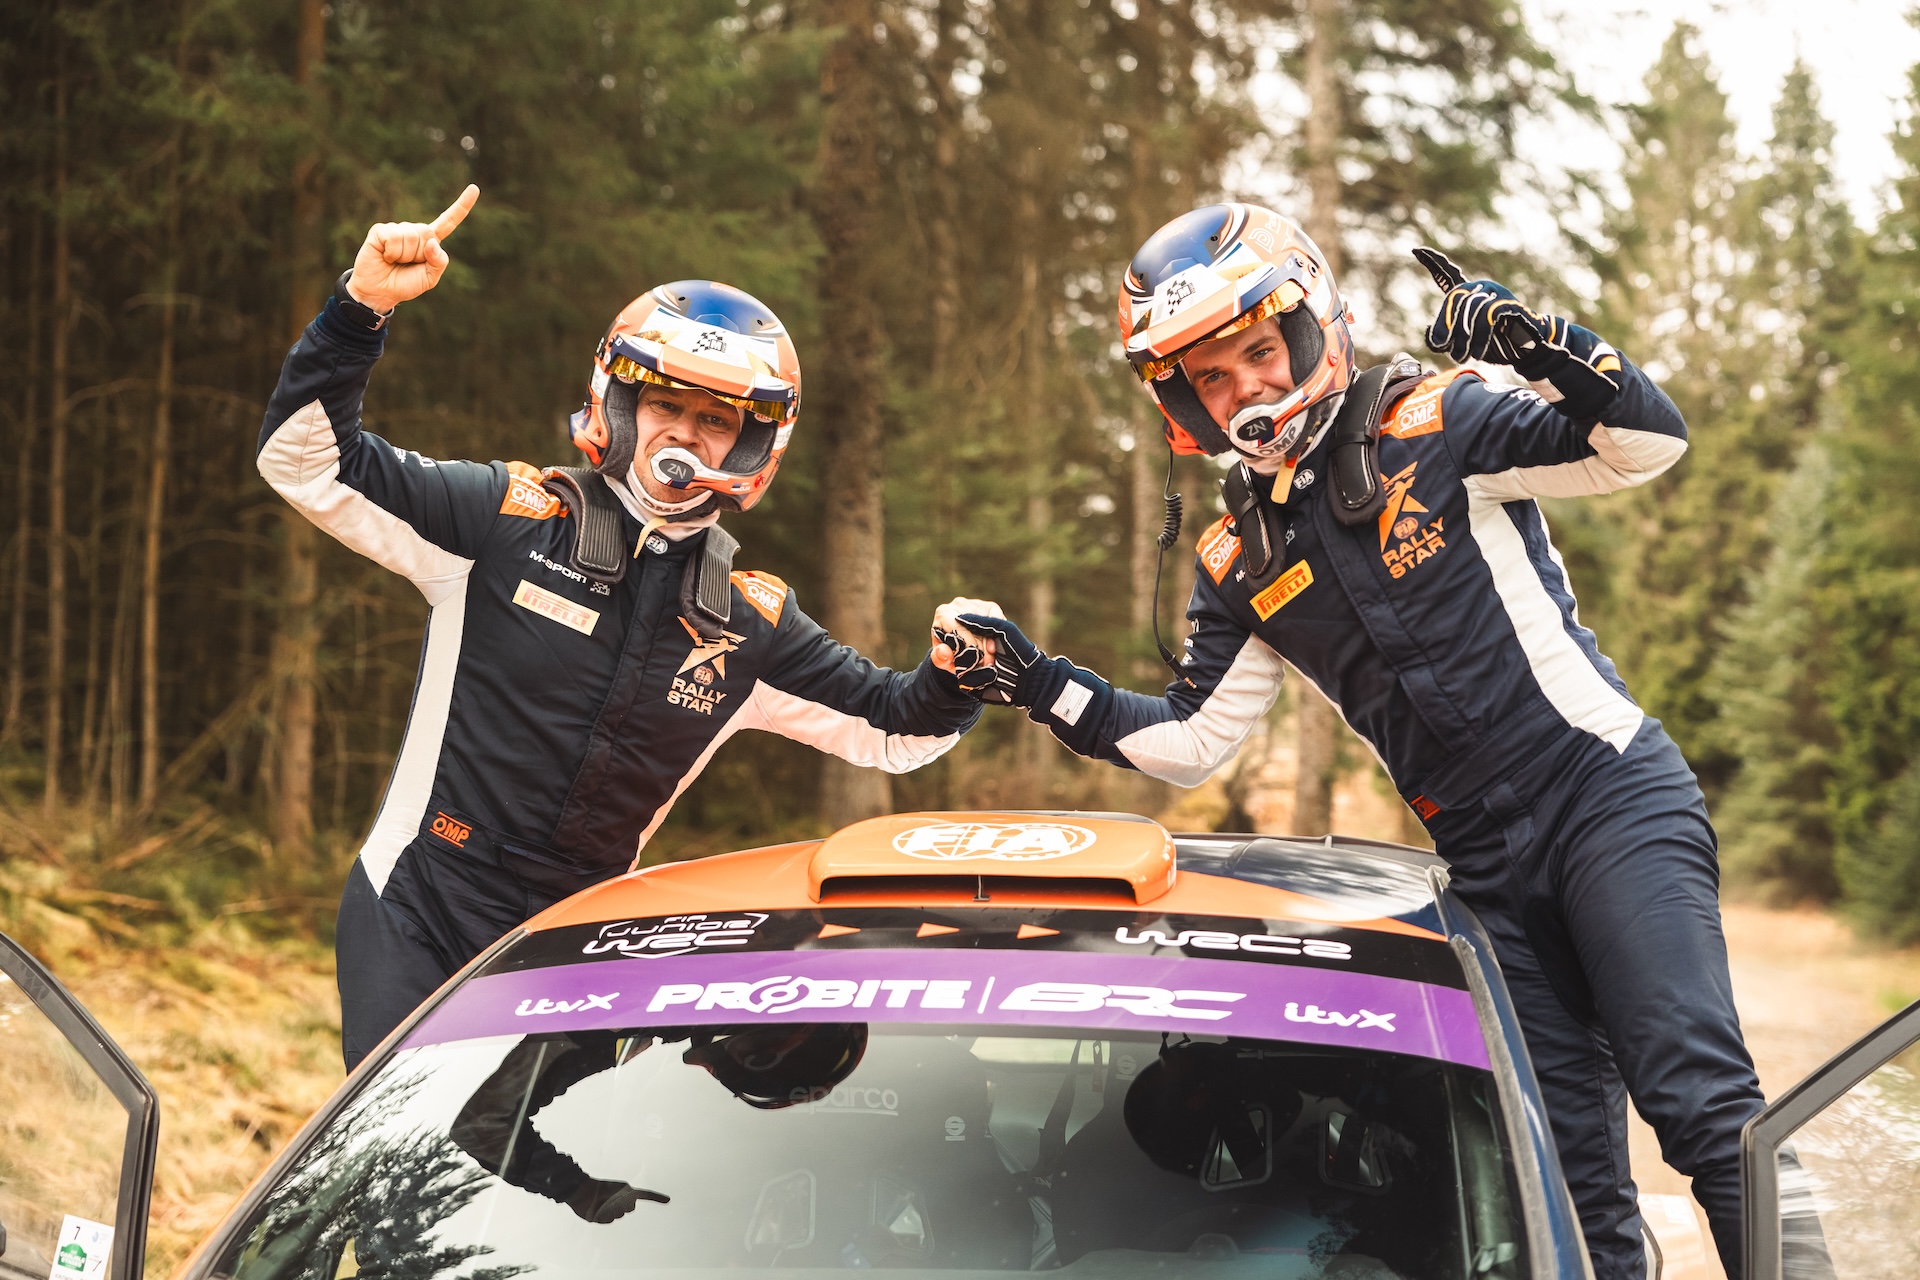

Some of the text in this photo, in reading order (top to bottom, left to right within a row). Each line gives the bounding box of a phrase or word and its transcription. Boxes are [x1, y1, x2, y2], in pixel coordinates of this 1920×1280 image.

[1400, 404, 1436, 428] OMP
[1259, 426, 1296, 455] OMP
[1294, 470, 1315, 488] FIA
[511, 487, 547, 511] OMP
[1394, 519, 1416, 537] FIA
[1209, 535, 1237, 569] OMP
[1381, 516, 1444, 568] RALLY
[529, 550, 588, 584] M-SPORT
[1389, 537, 1446, 580] STAR
[747, 586, 780, 611] OMP
[1257, 568, 1307, 614] PIRELLI
[522, 587, 591, 628] PIRELLI
[666, 690, 714, 716] STAR
[671, 677, 727, 705] RALLY
[432, 817, 470, 842] OMP
[904, 827, 1072, 851] FIA
[606, 919, 752, 937] JUNIOR
[664, 914, 708, 924] FIA
[582, 929, 755, 954] WRC
[1114, 926, 1353, 961] WRC2
[646, 975, 1248, 1021] PROBITE BRC
